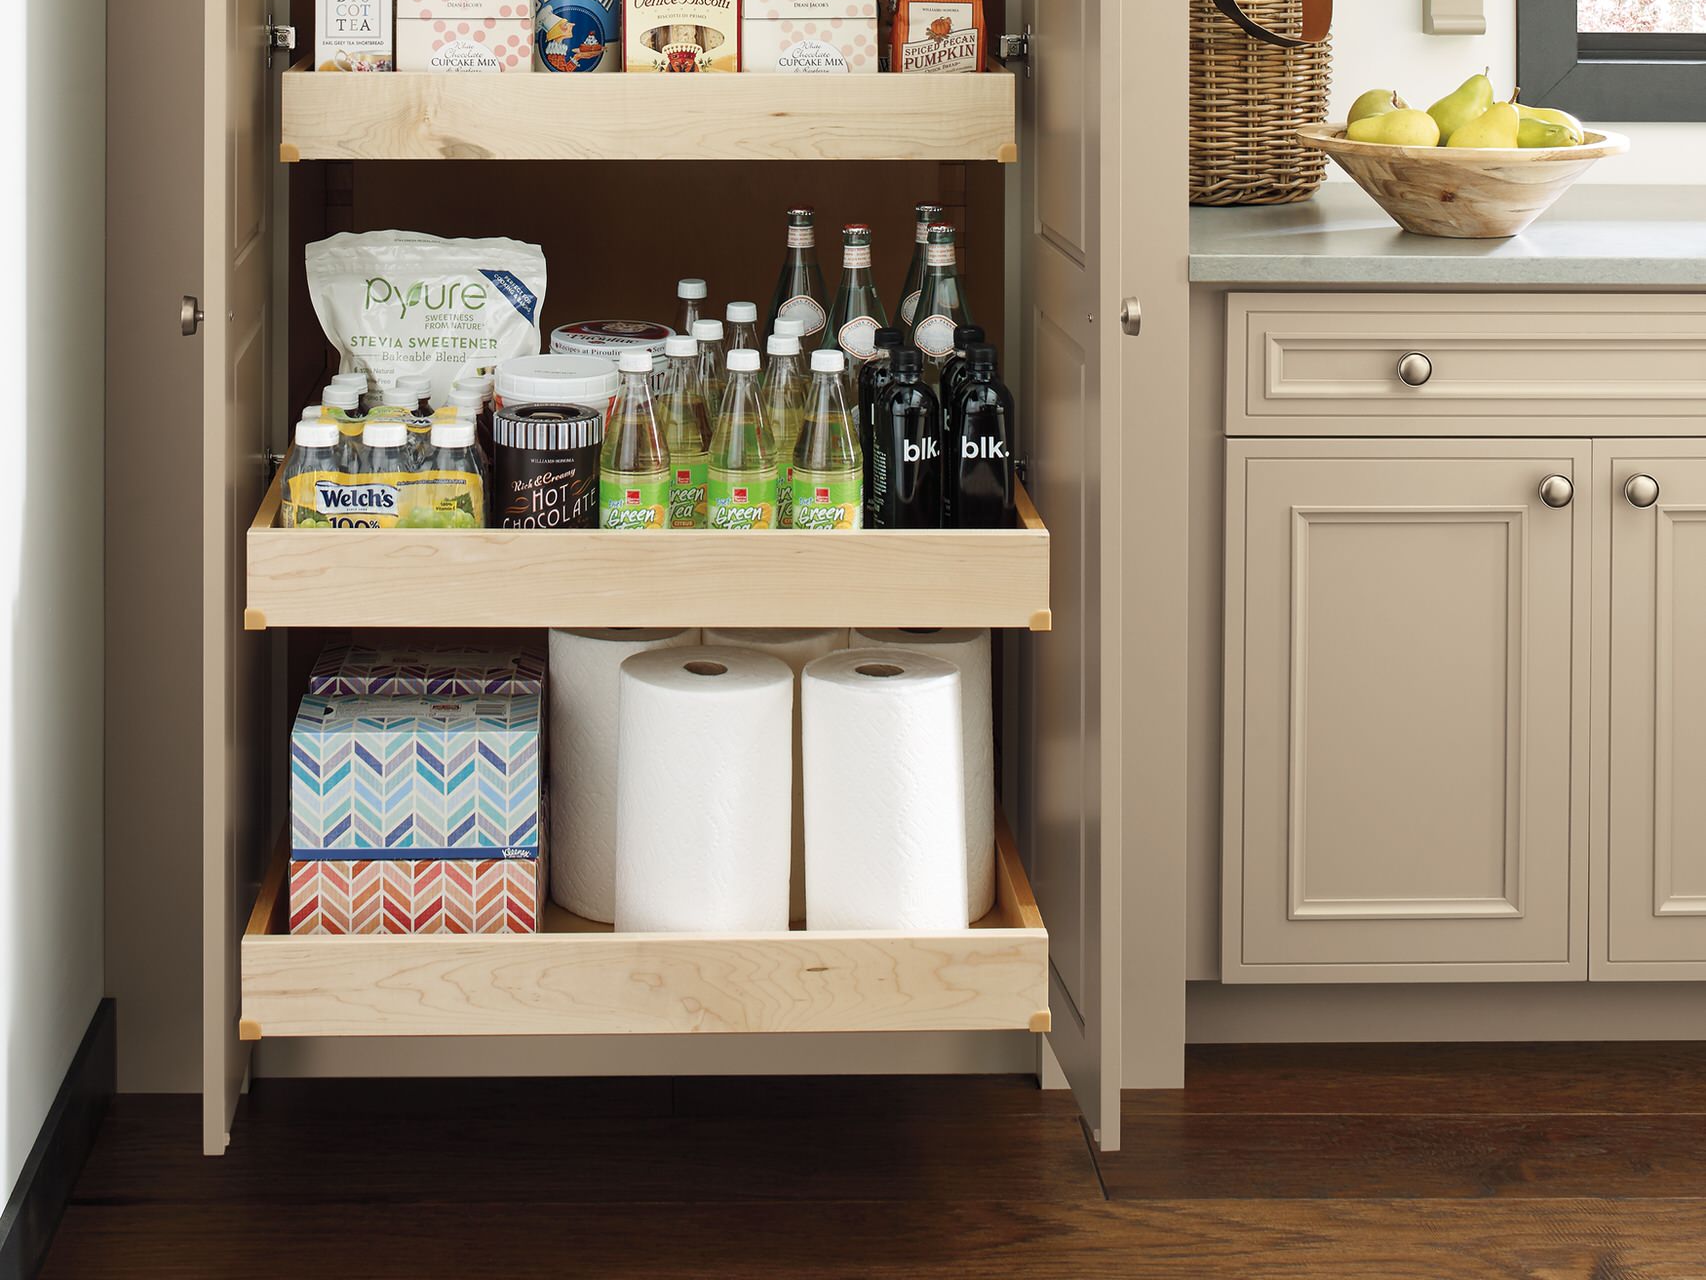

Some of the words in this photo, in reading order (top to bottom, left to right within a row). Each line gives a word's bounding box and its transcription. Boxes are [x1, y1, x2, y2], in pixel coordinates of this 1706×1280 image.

[336, 4, 371, 16] COT
[336, 19, 371, 31] TEA
[792, 47, 830, 59] Chocolate
[904, 43, 940, 56] SPICED
[943, 35, 976, 46] PECAN
[431, 57, 476, 66] CUPCAKE
[477, 58, 497, 66] MIX
[778, 57, 822, 66] CUPCAKE
[824, 58, 844, 66] MIX
[904, 44, 975, 70] PUMPKIN
[425, 322, 449, 330] FROM
[351, 336, 403, 348] STEVIA
[408, 337, 497, 349] SWEETENER
[382, 352, 432, 362] Bakeable
[436, 352, 466, 362] Blend
[903, 436, 940, 462] blk.
[961, 435, 1010, 459] blk.
[511, 478, 533, 492] Rich
[534, 475, 542, 487] &
[542, 468, 576, 484] Creamy
[319, 489, 394, 508] Welch's
[532, 483, 568, 512] HOT
[670, 488, 704, 502] reen
[503, 487, 596, 529] CHOCOLATE
[716, 507, 762, 524] Green
[799, 506, 845, 524] Green
[608, 509, 655, 526] Green
